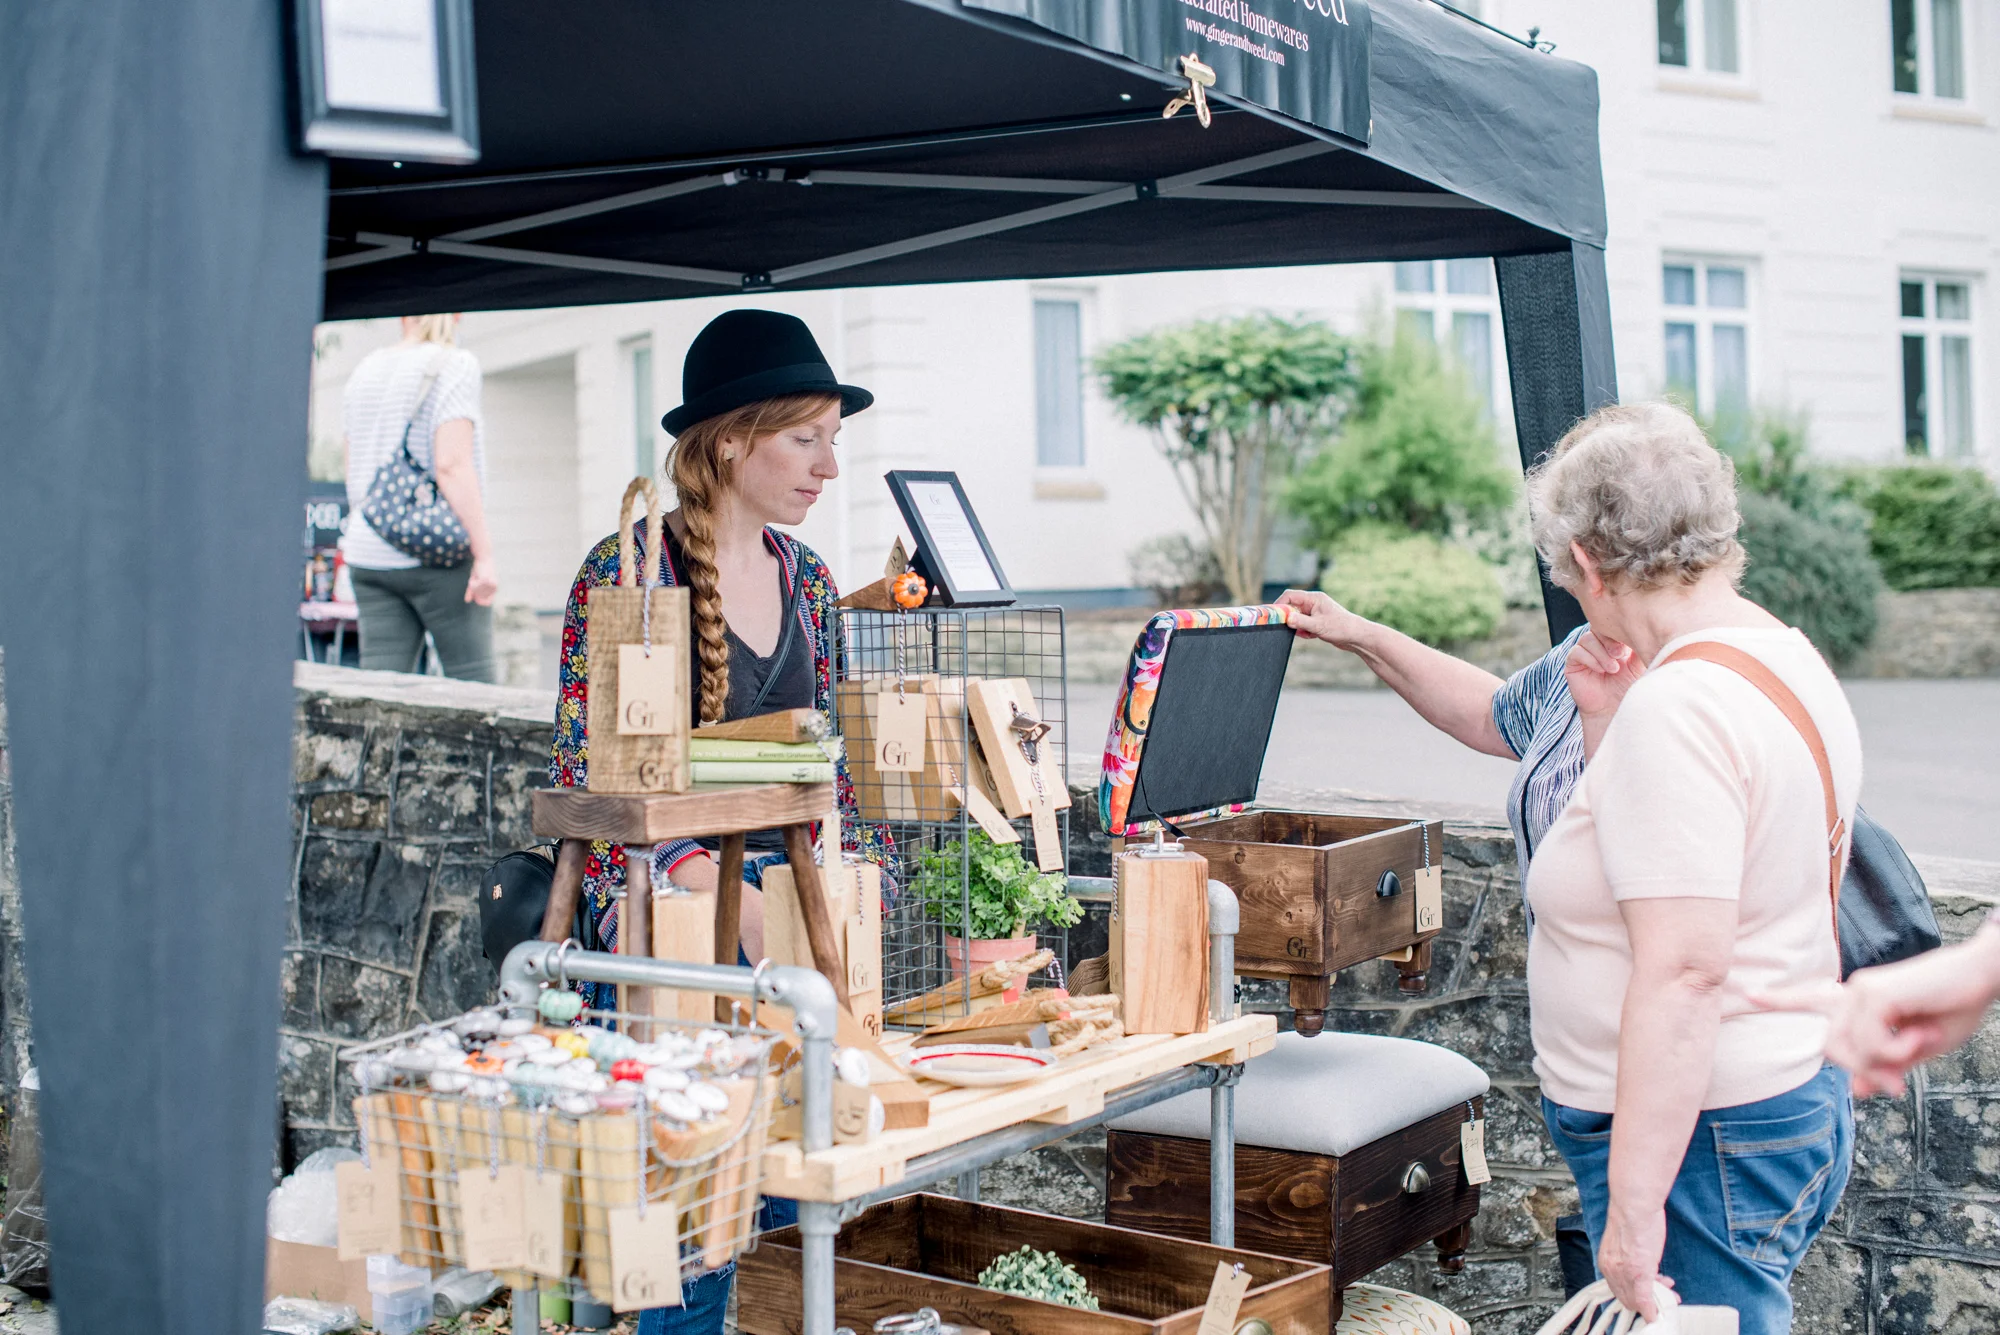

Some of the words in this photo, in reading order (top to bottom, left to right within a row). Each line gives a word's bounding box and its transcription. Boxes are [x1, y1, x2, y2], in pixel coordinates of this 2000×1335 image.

[1179, 0, 1239, 23] rafted
[1240, 0, 1309, 52] Homewares
[1185, 17, 1285, 66] www.gingerandtweed.com
[882, 740, 911, 767] GT
[1420, 906, 1435, 928] GT
